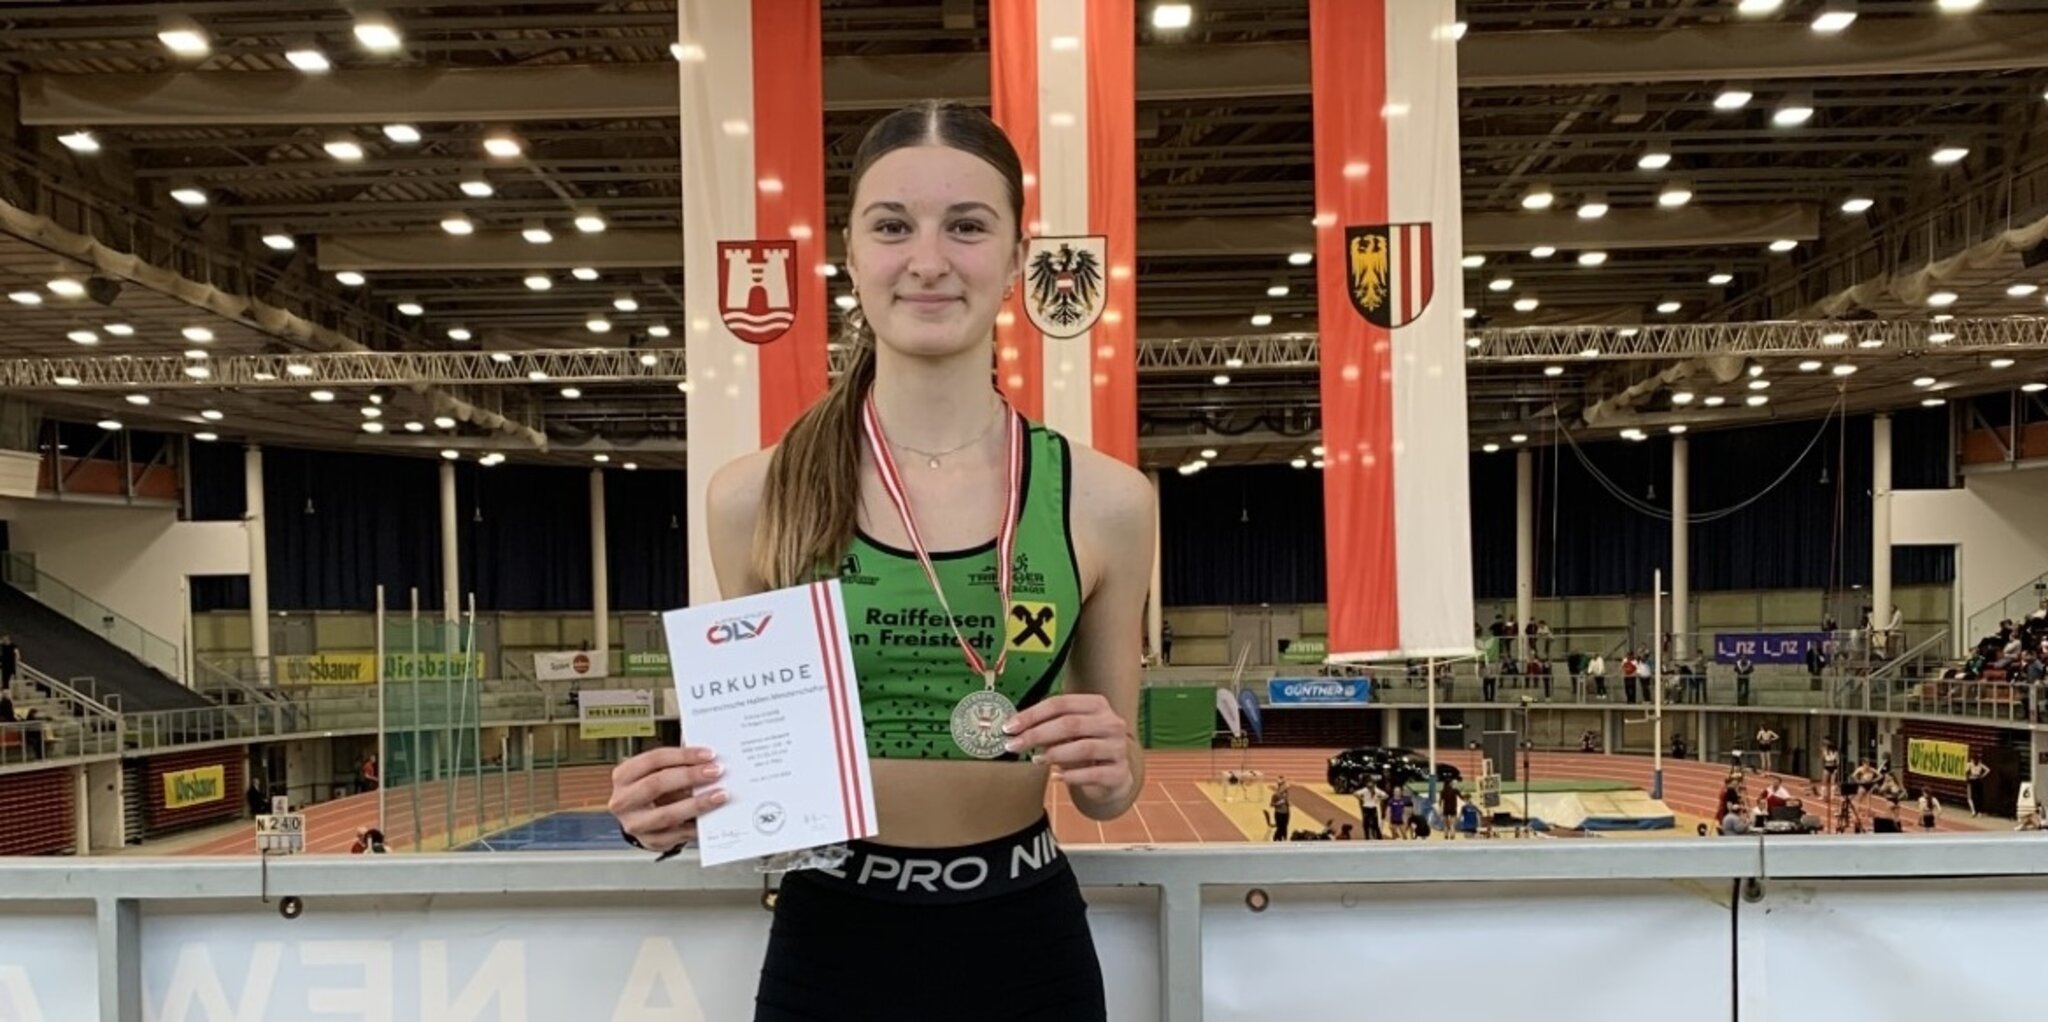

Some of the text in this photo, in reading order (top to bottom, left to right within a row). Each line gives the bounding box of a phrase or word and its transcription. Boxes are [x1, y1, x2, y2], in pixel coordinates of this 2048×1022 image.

[865, 607, 996, 629] Raiffeisen
[849, 629, 995, 650] n Freistadt
[691, 663, 812, 700] URKUNDE
[1284, 682, 1344, 697] GÜNTHER
[857, 854, 989, 893] PRO
